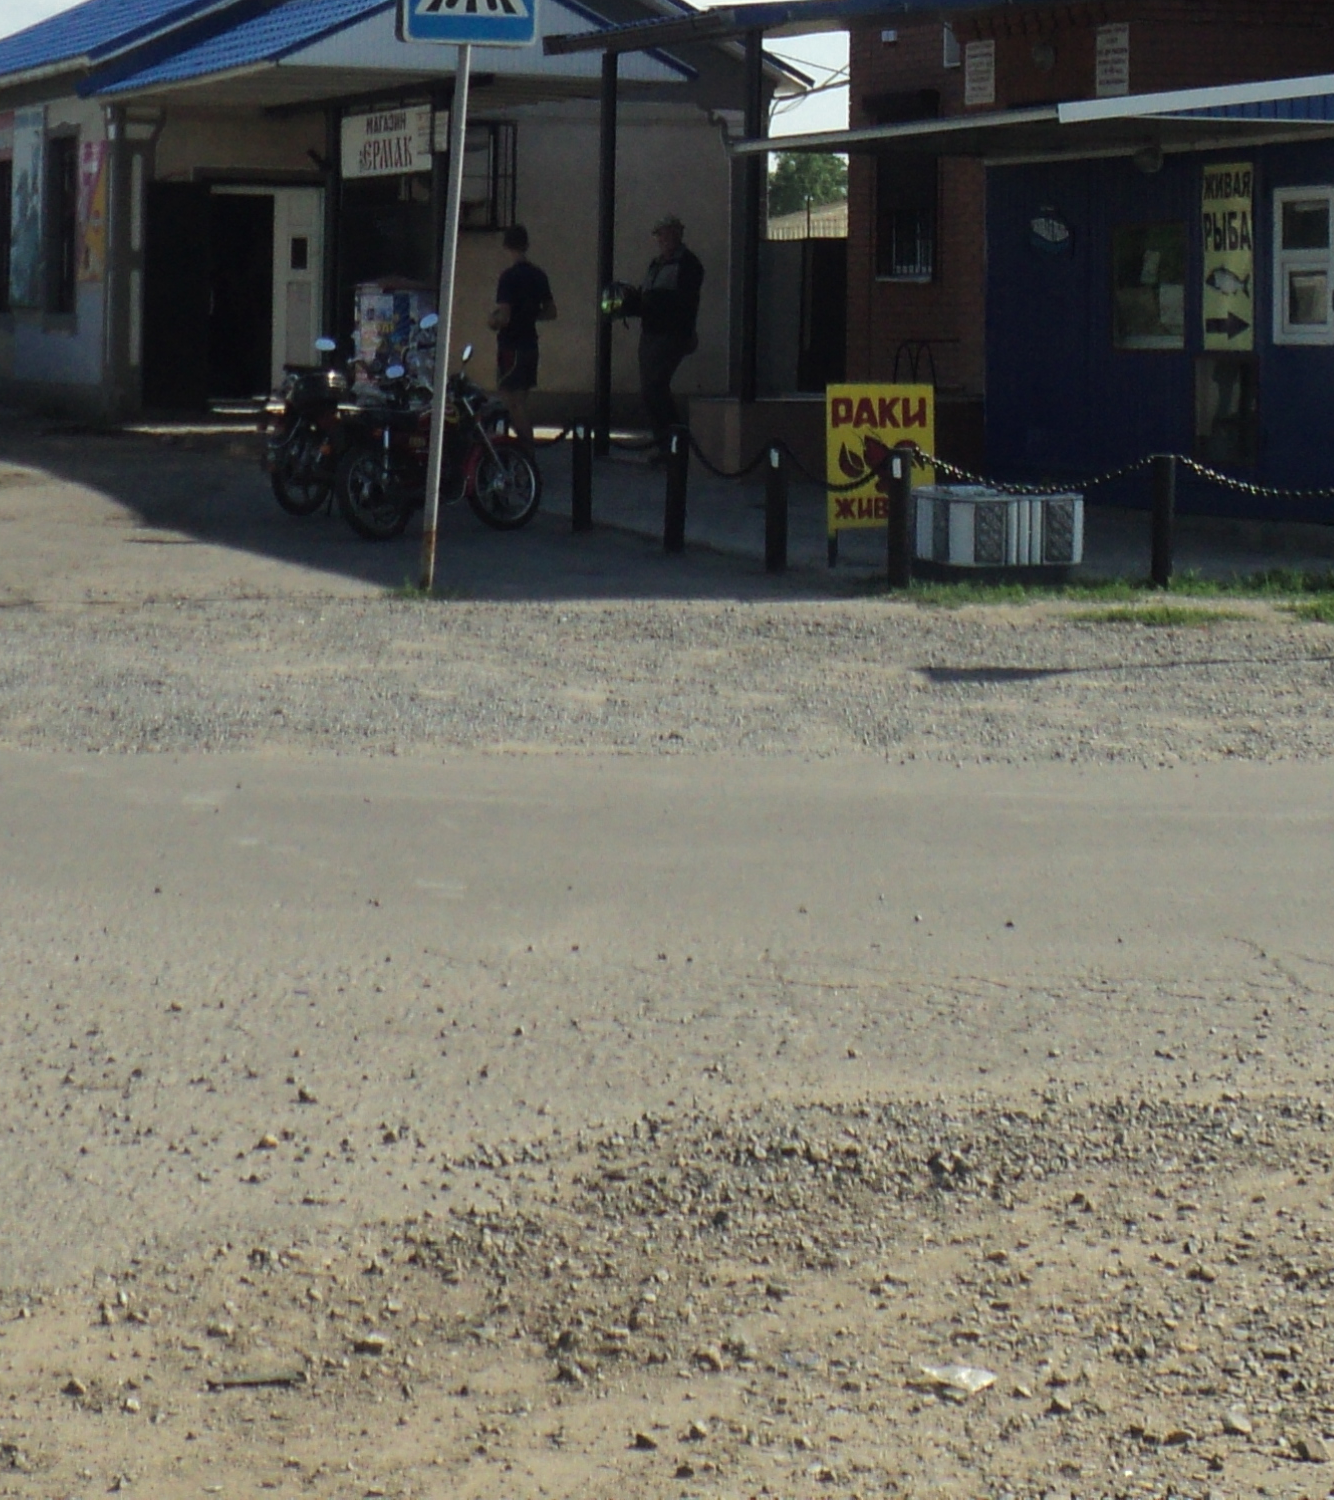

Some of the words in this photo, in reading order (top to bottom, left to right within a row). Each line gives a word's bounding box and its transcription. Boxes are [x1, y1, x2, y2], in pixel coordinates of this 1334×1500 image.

[366, 112, 407, 135] МАГАЗИН
[1204, 172, 1251, 199] ЖИВАЯ
[1203, 211, 1252, 251] РЫБА
[831, 397, 926, 429] РАКИ
[835, 497, 889, 519] ЖИВ
